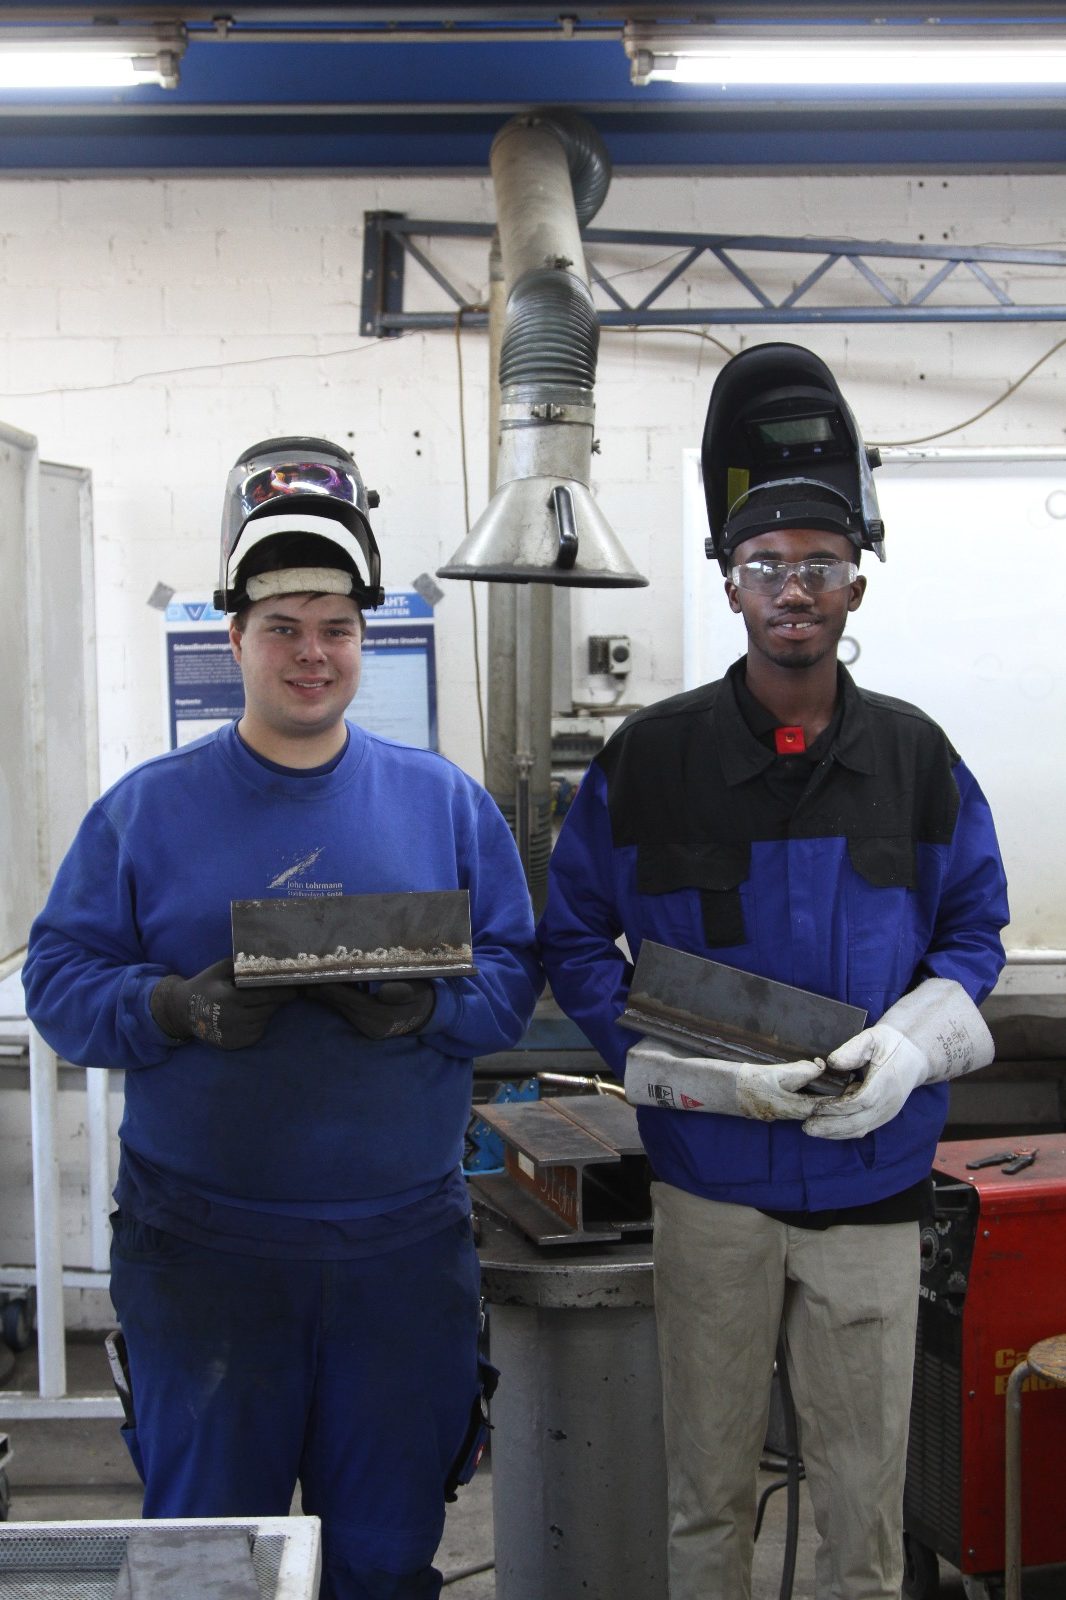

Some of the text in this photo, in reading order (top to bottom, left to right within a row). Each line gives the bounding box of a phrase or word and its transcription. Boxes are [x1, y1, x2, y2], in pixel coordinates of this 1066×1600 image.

[287, 880, 343, 890] John Lohrmann
[995, 1348, 1029, 1370] Ca
